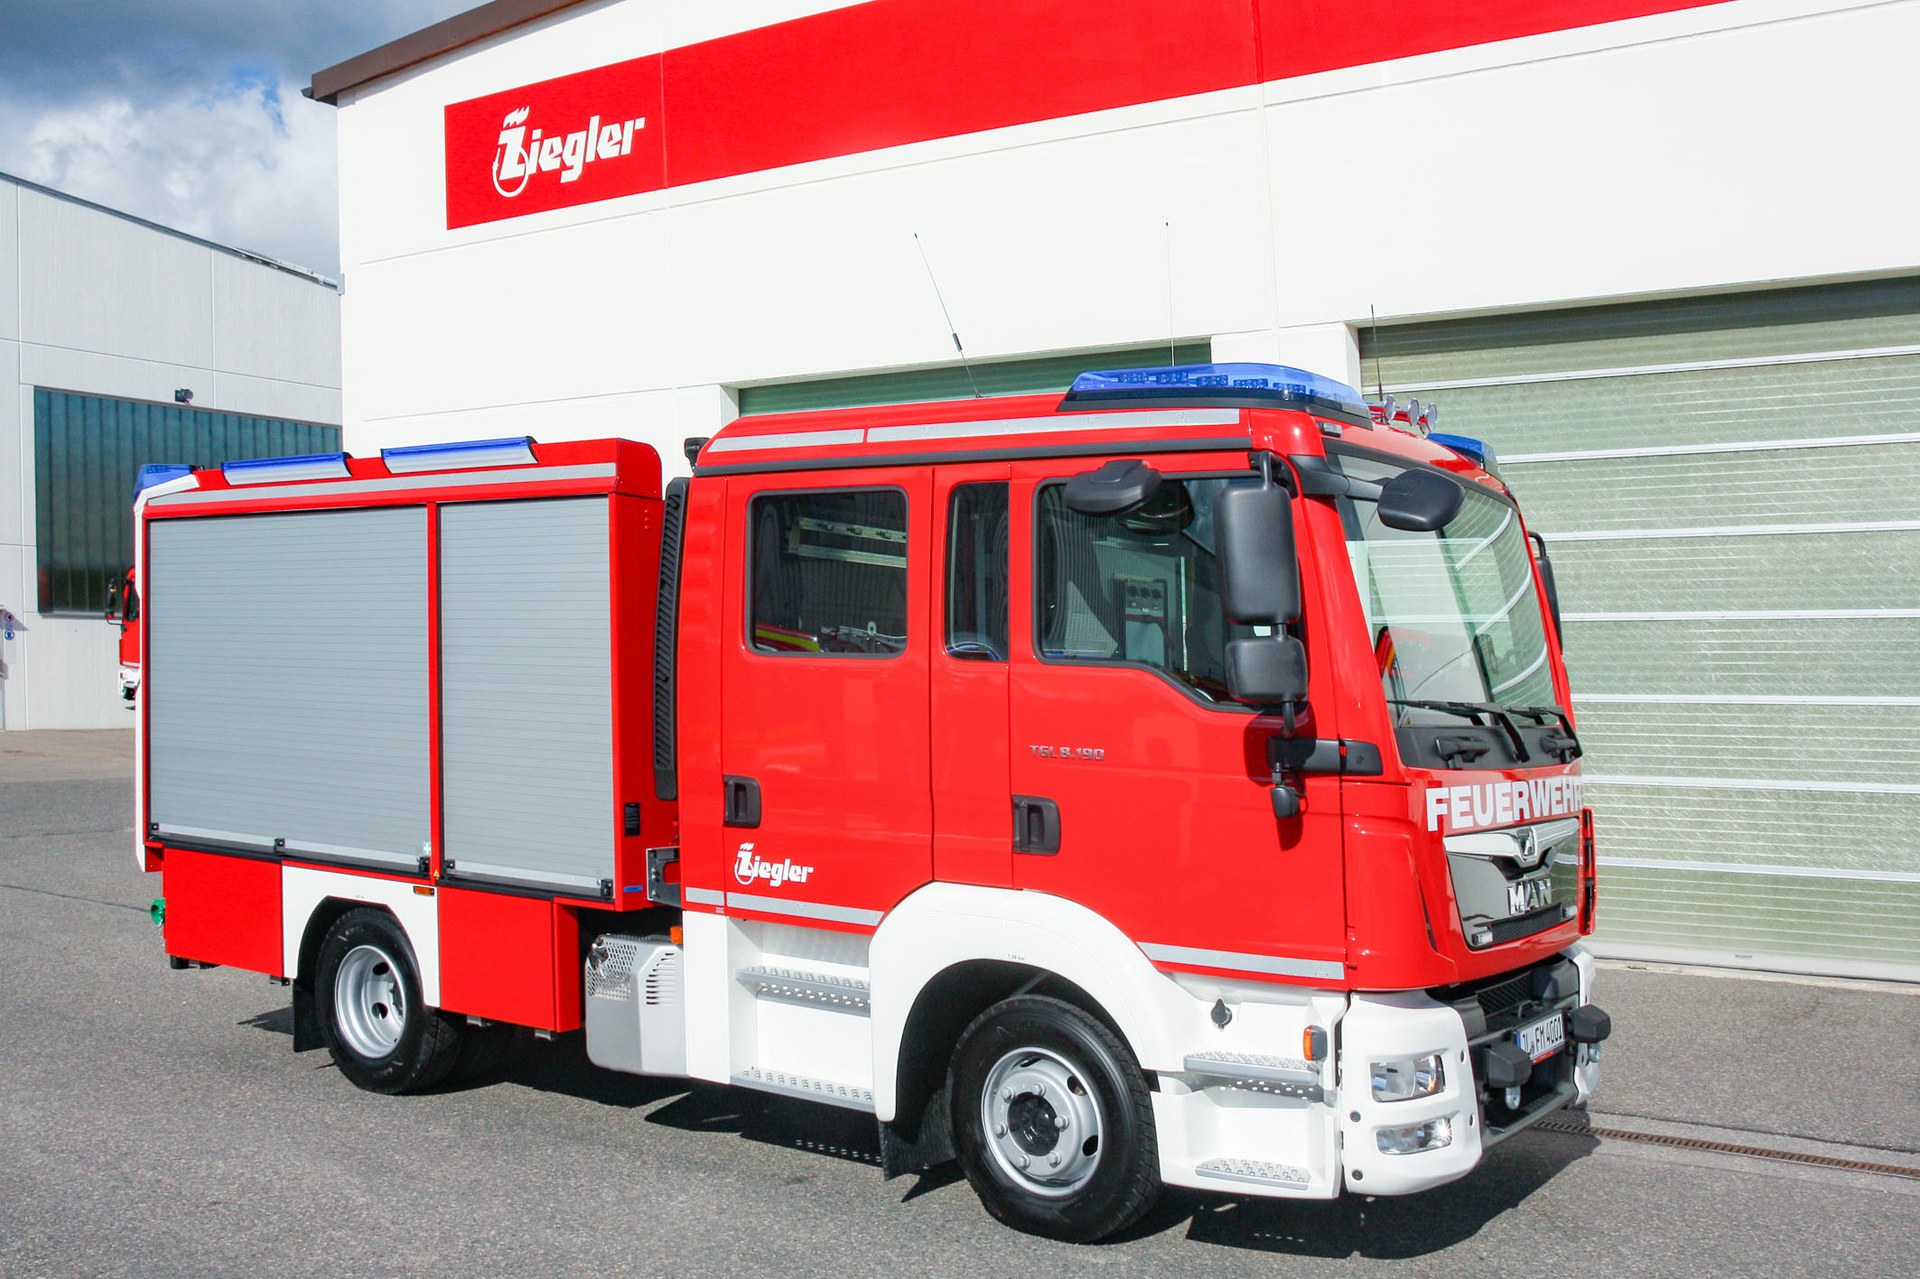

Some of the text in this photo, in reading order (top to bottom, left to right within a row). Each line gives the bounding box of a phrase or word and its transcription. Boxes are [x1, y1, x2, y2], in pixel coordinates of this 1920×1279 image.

[492, 111, 646, 197] Ziegler
[1029, 745, 1105, 761] TGL 8.190
[1426, 776, 1584, 832] FEUERWEHR
[734, 847, 814, 887] Ziegler
[1507, 878, 1552, 915] MAN
